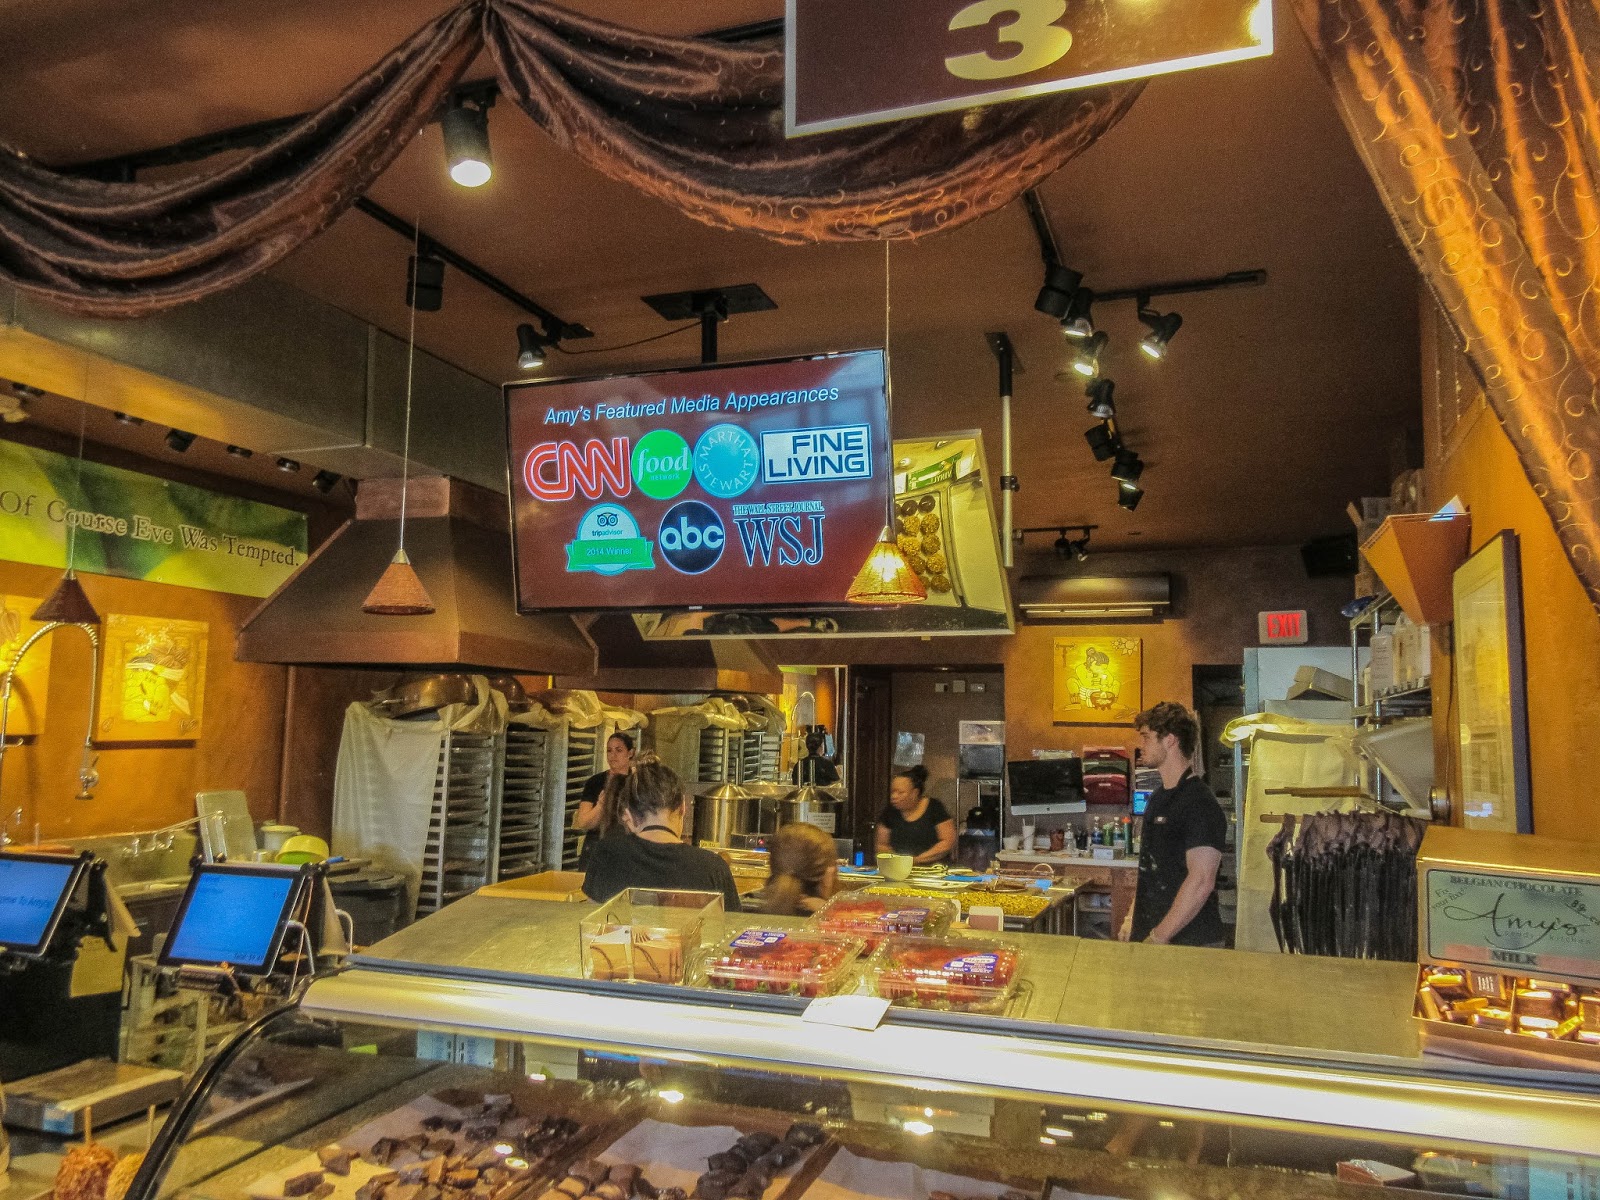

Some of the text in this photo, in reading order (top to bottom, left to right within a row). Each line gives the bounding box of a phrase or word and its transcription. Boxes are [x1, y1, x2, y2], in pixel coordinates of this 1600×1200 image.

[945, 0, 1073, 80] 3
[544, 388, 839, 427] Amy's Featured Media Appearances
[700, 431, 752, 461] MARTHA
[792, 430, 865, 455] FINE
[524, 437, 632, 501] CNN
[636, 446, 690, 484] food
[700, 461, 754, 490] STEWART
[769, 452, 866, 478] LIVING
[0, 490, 300, 567] Of Course Eve Was Tempted.
[591, 529, 623, 537] tripadvisor
[660, 516, 724, 550] abc
[733, 515, 825, 567] WSJ
[586, 546, 632, 556] 2014 Winner
[1267, 613, 1301, 638] EXIT
[1450, 876, 1584, 896] BELGIAN CHOCOLATE
[1491, 950, 1537, 965] MILK
